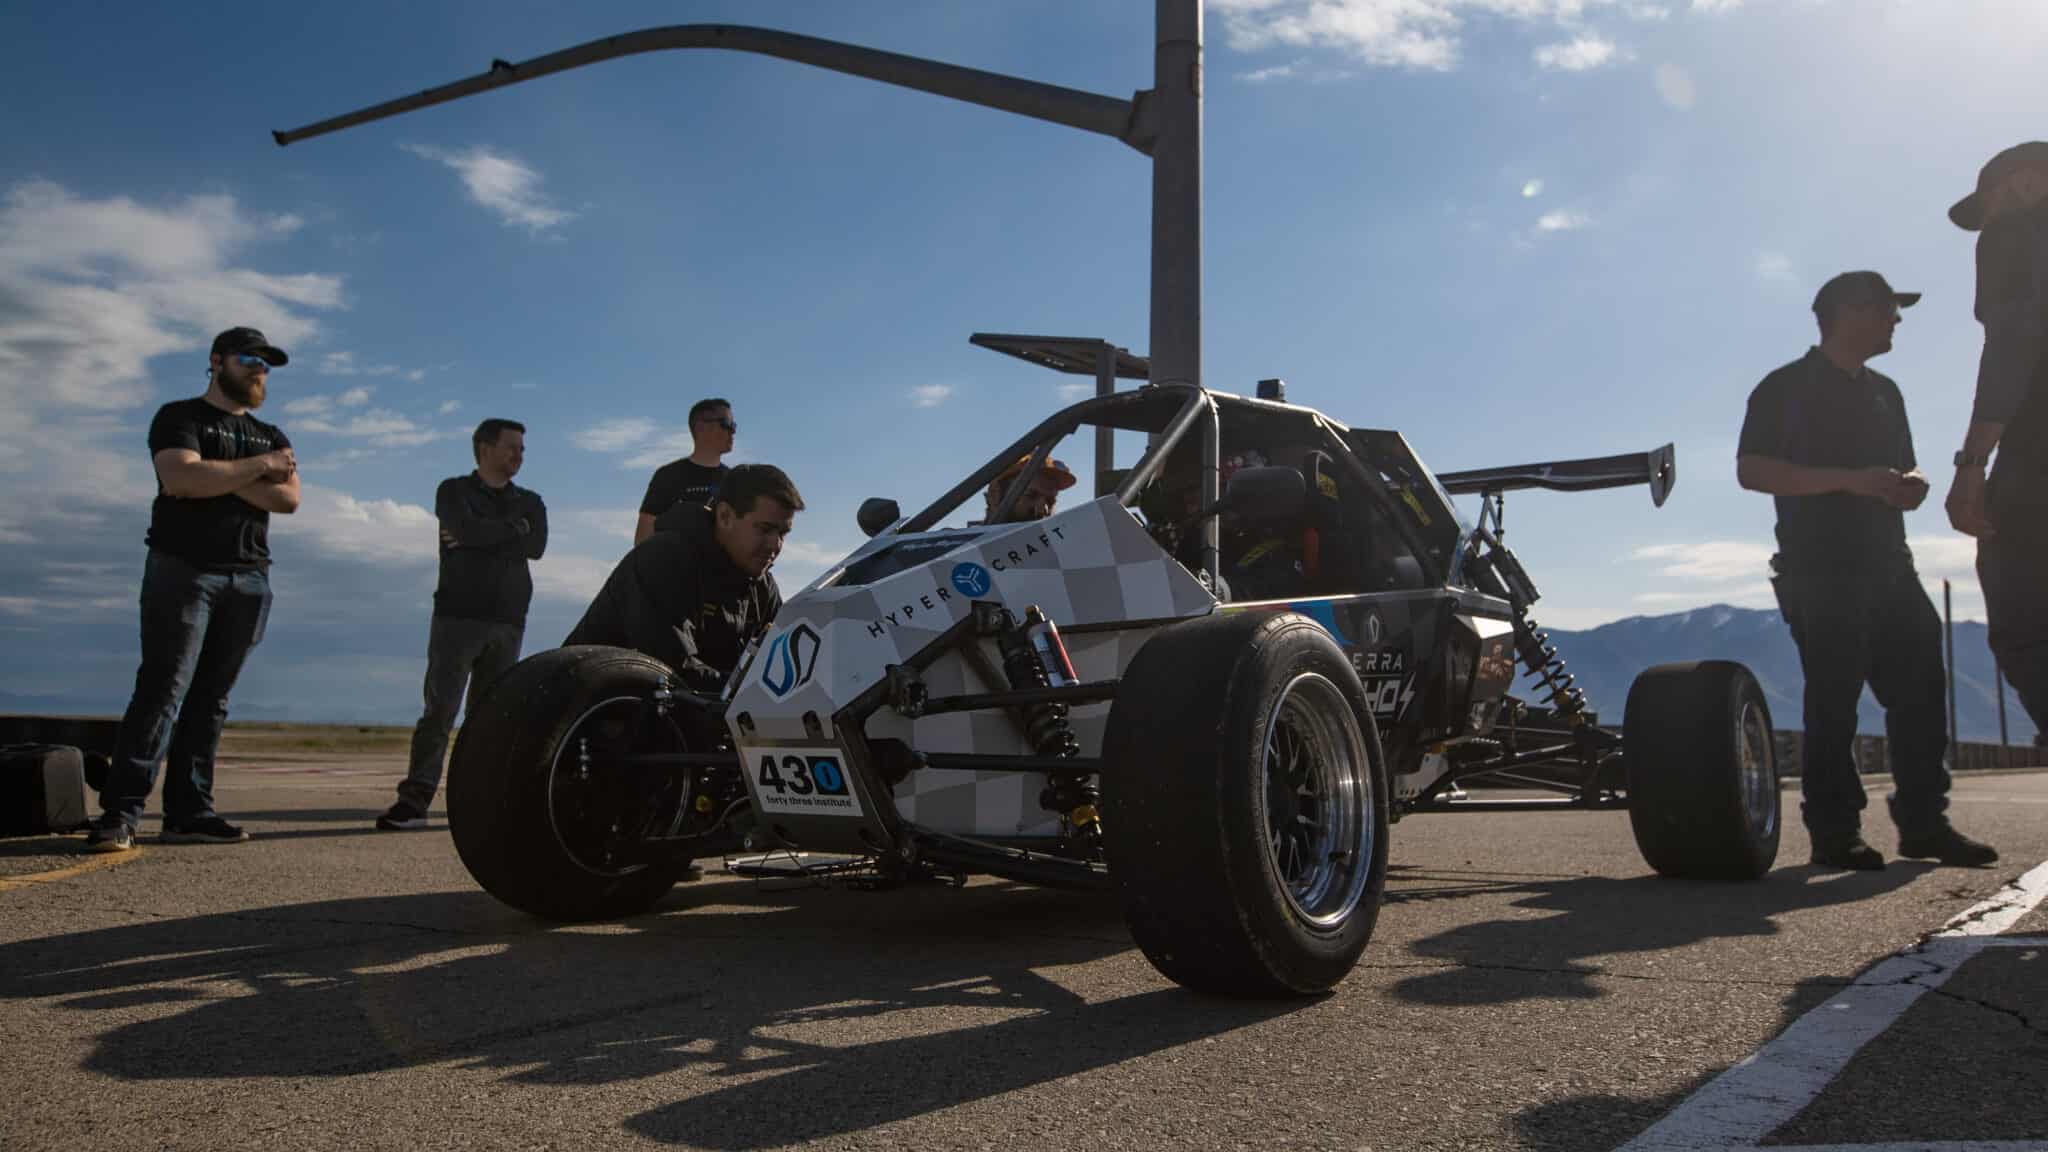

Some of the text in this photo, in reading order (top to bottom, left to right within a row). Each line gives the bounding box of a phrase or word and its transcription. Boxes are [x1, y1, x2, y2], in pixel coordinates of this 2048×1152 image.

[867, 527, 1065, 638] HYPER CRAFT
[1353, 652, 1402, 671] ERRA
[766, 795, 852, 807] forty three institute
